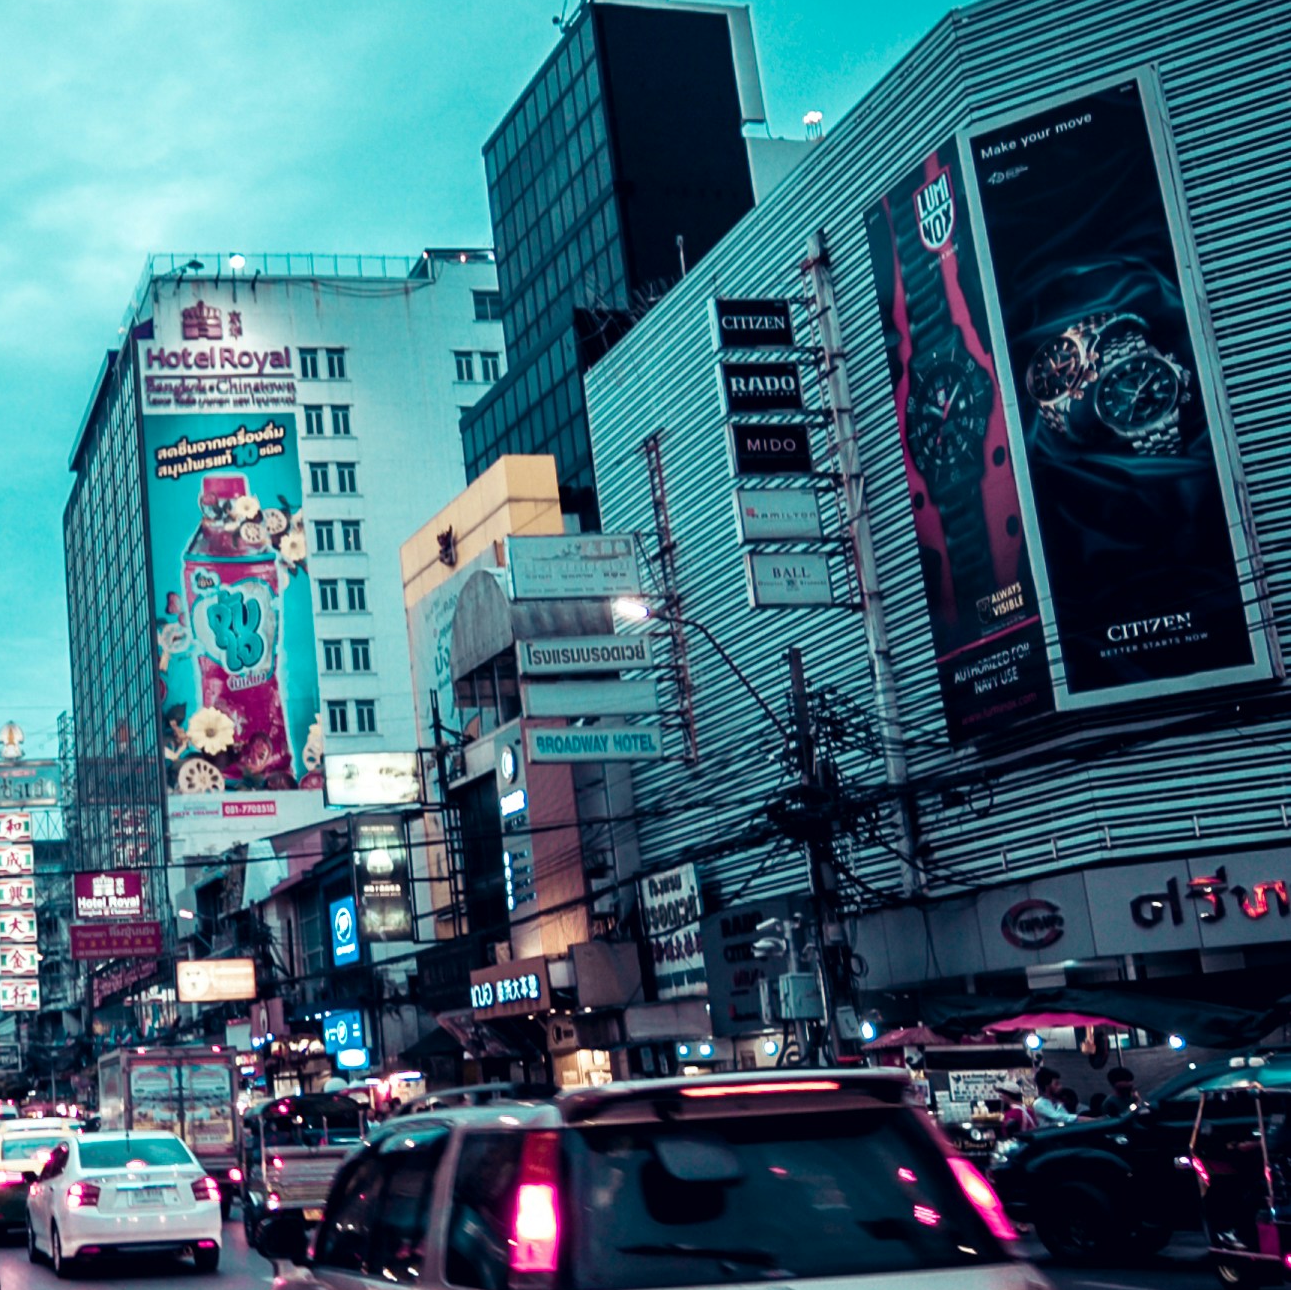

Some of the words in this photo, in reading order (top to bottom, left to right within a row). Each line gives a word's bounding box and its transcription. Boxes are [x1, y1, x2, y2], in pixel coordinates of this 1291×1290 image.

[980, 140, 1017, 160] Make
[1020, 127, 1051, 148] your
[1054, 113, 1092, 134] move
[917, 172, 950, 216] LUMI
[920, 204, 953, 245] NOX
[721, 315, 786, 330] CITIZEN
[147, 346, 216, 369] Hotel
[219, 346, 292, 376] Royal
[731, 375, 796, 391] RADO
[232, 443, 259, 468] 10
[746, 438, 797, 452] MIDO
[772, 567, 811, 579] BALL
[991, 581, 1023, 603] ALWAYS
[992, 594, 1025, 617] VISIBLE
[1107, 611, 1192, 642] CITIZEN
[1142, 636, 1181, 651] STARTS
[1185, 631, 1209, 643] NOW
[954, 651, 1010, 685] AUTHORIZED
[975, 676, 1000, 696] NAVY
[1000, 666, 1019, 687] USE
[536, 734, 609, 753] BROADWAY
[613, 733, 657, 752] HOTEL
